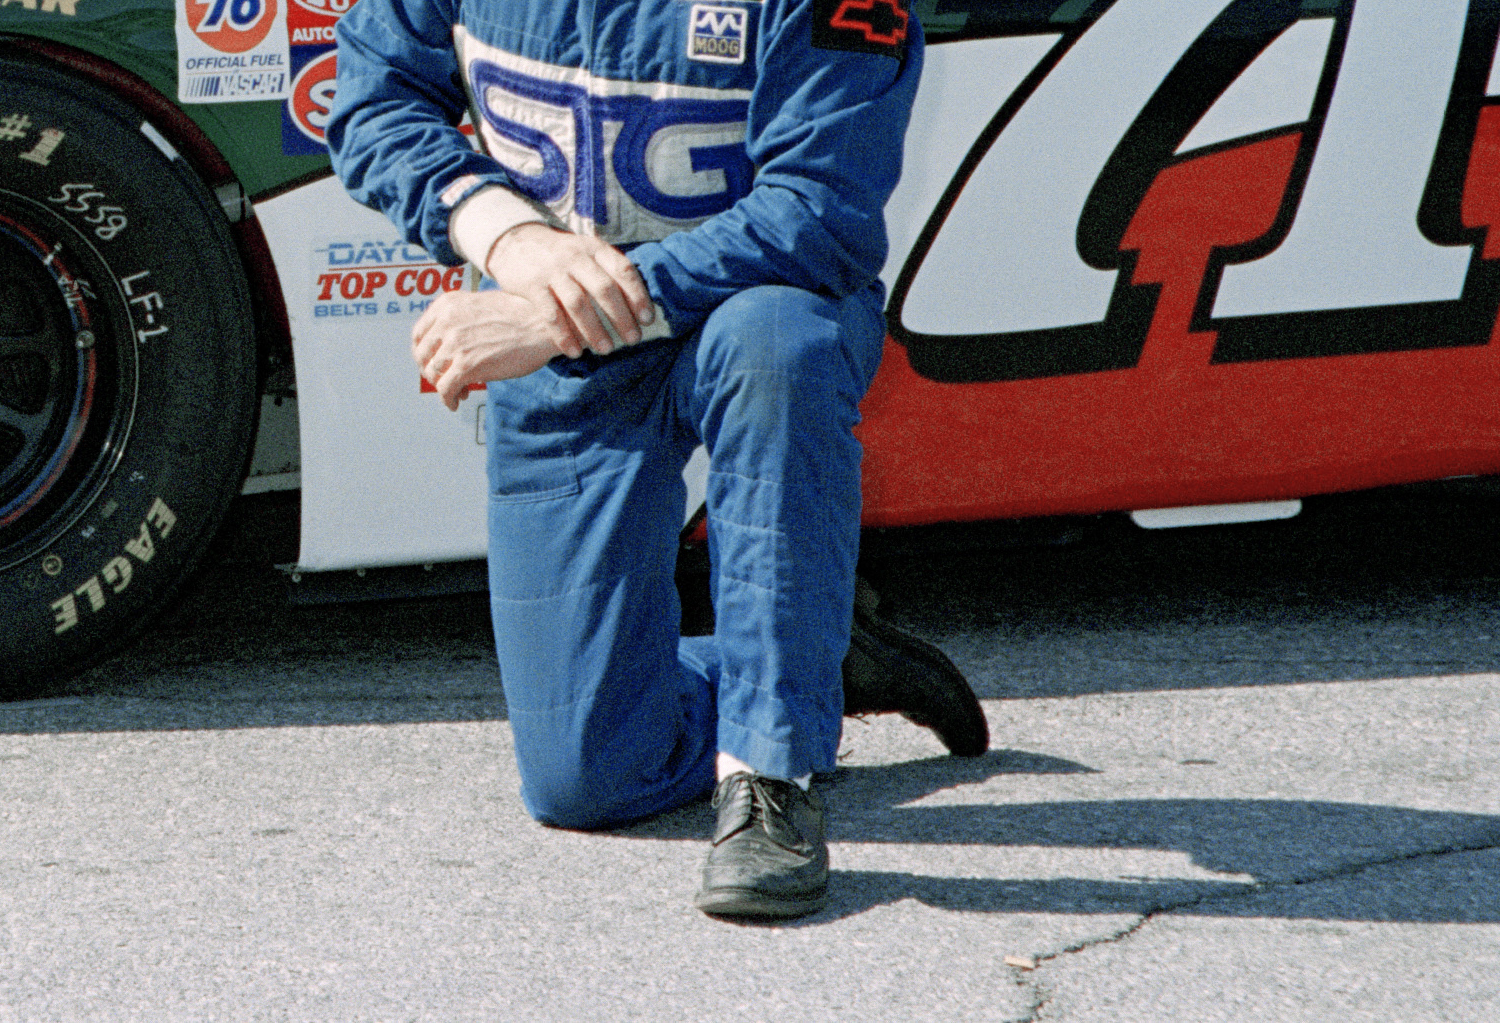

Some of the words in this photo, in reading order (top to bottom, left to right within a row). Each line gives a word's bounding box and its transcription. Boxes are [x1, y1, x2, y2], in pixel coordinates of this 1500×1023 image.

[293, 27, 336, 43] AUTO
[694, 37, 740, 55] MOOG
[186, 56, 247, 71] OFFICIAL
[251, 54, 285, 67] FUEL
[219, 73, 286, 96] NASCAR
[328, 239, 428, 265] DAYC
[317, 271, 388, 300] TOP
[394, 267, 464, 297] COG
[315, 302, 378, 317] BELTS
[387, 301, 401, 314] &
[49, 497, 178, 635] EAGLE
